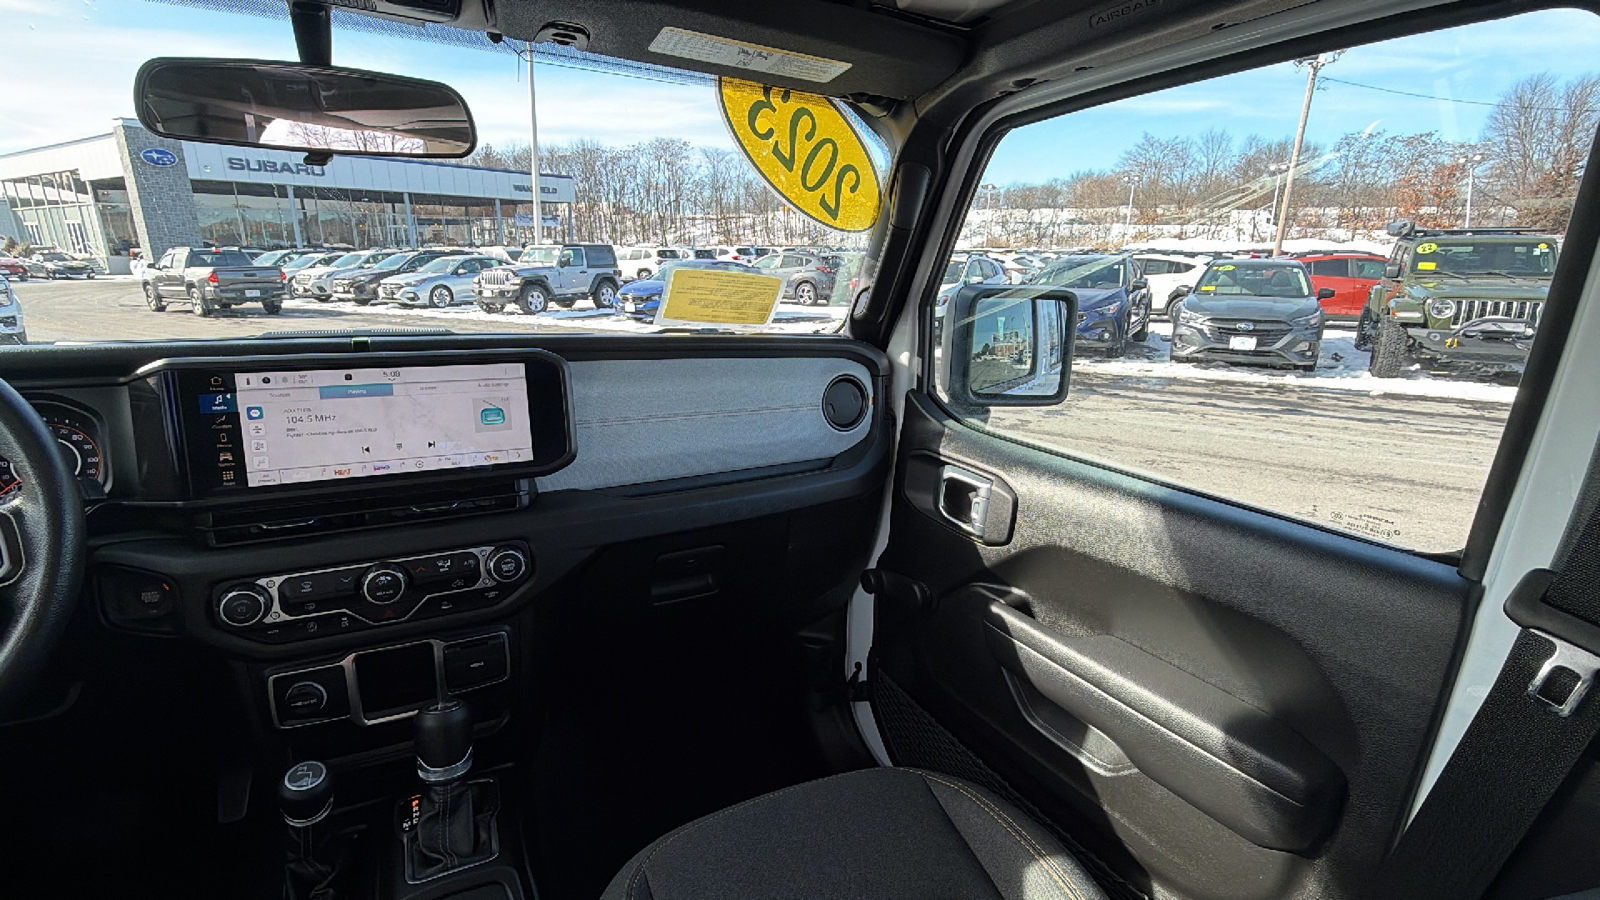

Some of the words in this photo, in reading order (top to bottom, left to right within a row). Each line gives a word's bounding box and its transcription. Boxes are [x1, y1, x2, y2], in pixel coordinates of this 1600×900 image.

[228, 157, 325, 177] SUBARU
[512, 184, 558, 194] WAKIELD
[286, 414, 313, 424] 104.5
[314, 414, 337, 423] MHz
